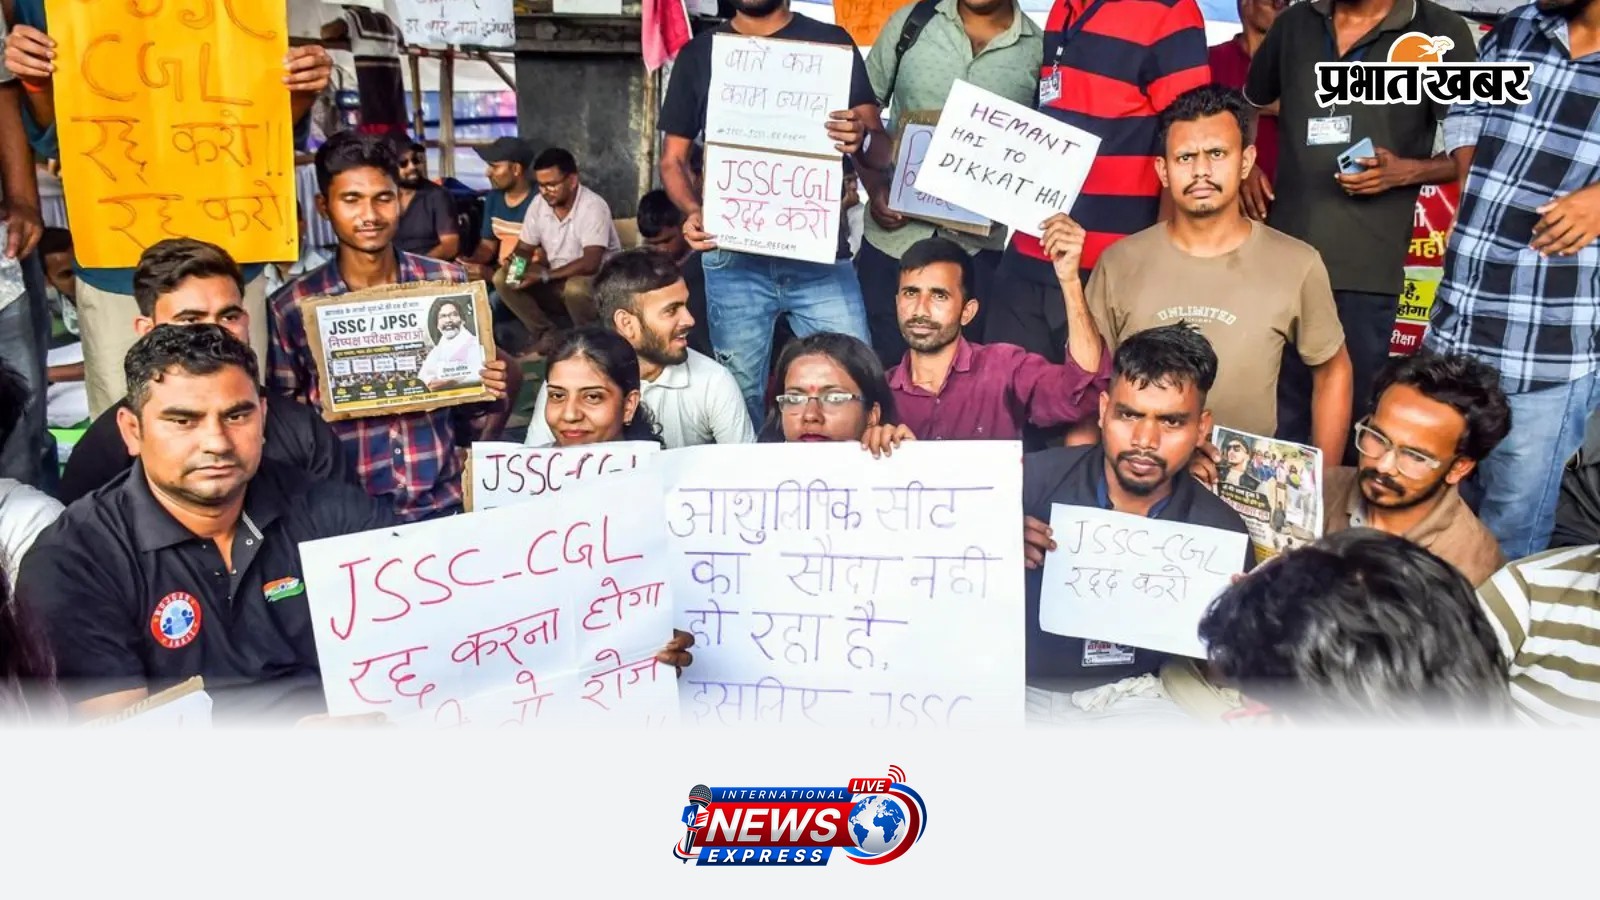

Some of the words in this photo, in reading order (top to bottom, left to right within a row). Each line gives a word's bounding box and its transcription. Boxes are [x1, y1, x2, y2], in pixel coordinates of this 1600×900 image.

[81, 33, 255, 106] CGL
[782, 52, 824, 75] कम
[721, 83, 768, 110] काम
[950, 126, 987, 149] HAI
[1003, 147, 1027, 164] TO
[970, 102, 1081, 156] HEMANT
[717, 159, 838, 202] JSSC-CGL
[938, 152, 1034, 196] DIKKAT
[1034, 185, 1068, 210] HAI
[775, 199, 831, 240] करो
[329, 318, 367, 336] JSSC
[379, 313, 418, 331] JPSC
[1157, 305, 1237, 325] UNLIMITED
[1397, 301, 1429, 318] होगा
[872, 480, 994, 532] सीट
[1068, 519, 1227, 576] JSSC-CGL
[684, 551, 752, 595] का
[1131, 563, 1191, 603] करो
[451, 607, 560, 666] करना
[582, 576, 665, 631] होगा
[684, 598, 740, 650] हो
[750, 610, 835, 665] रहा
